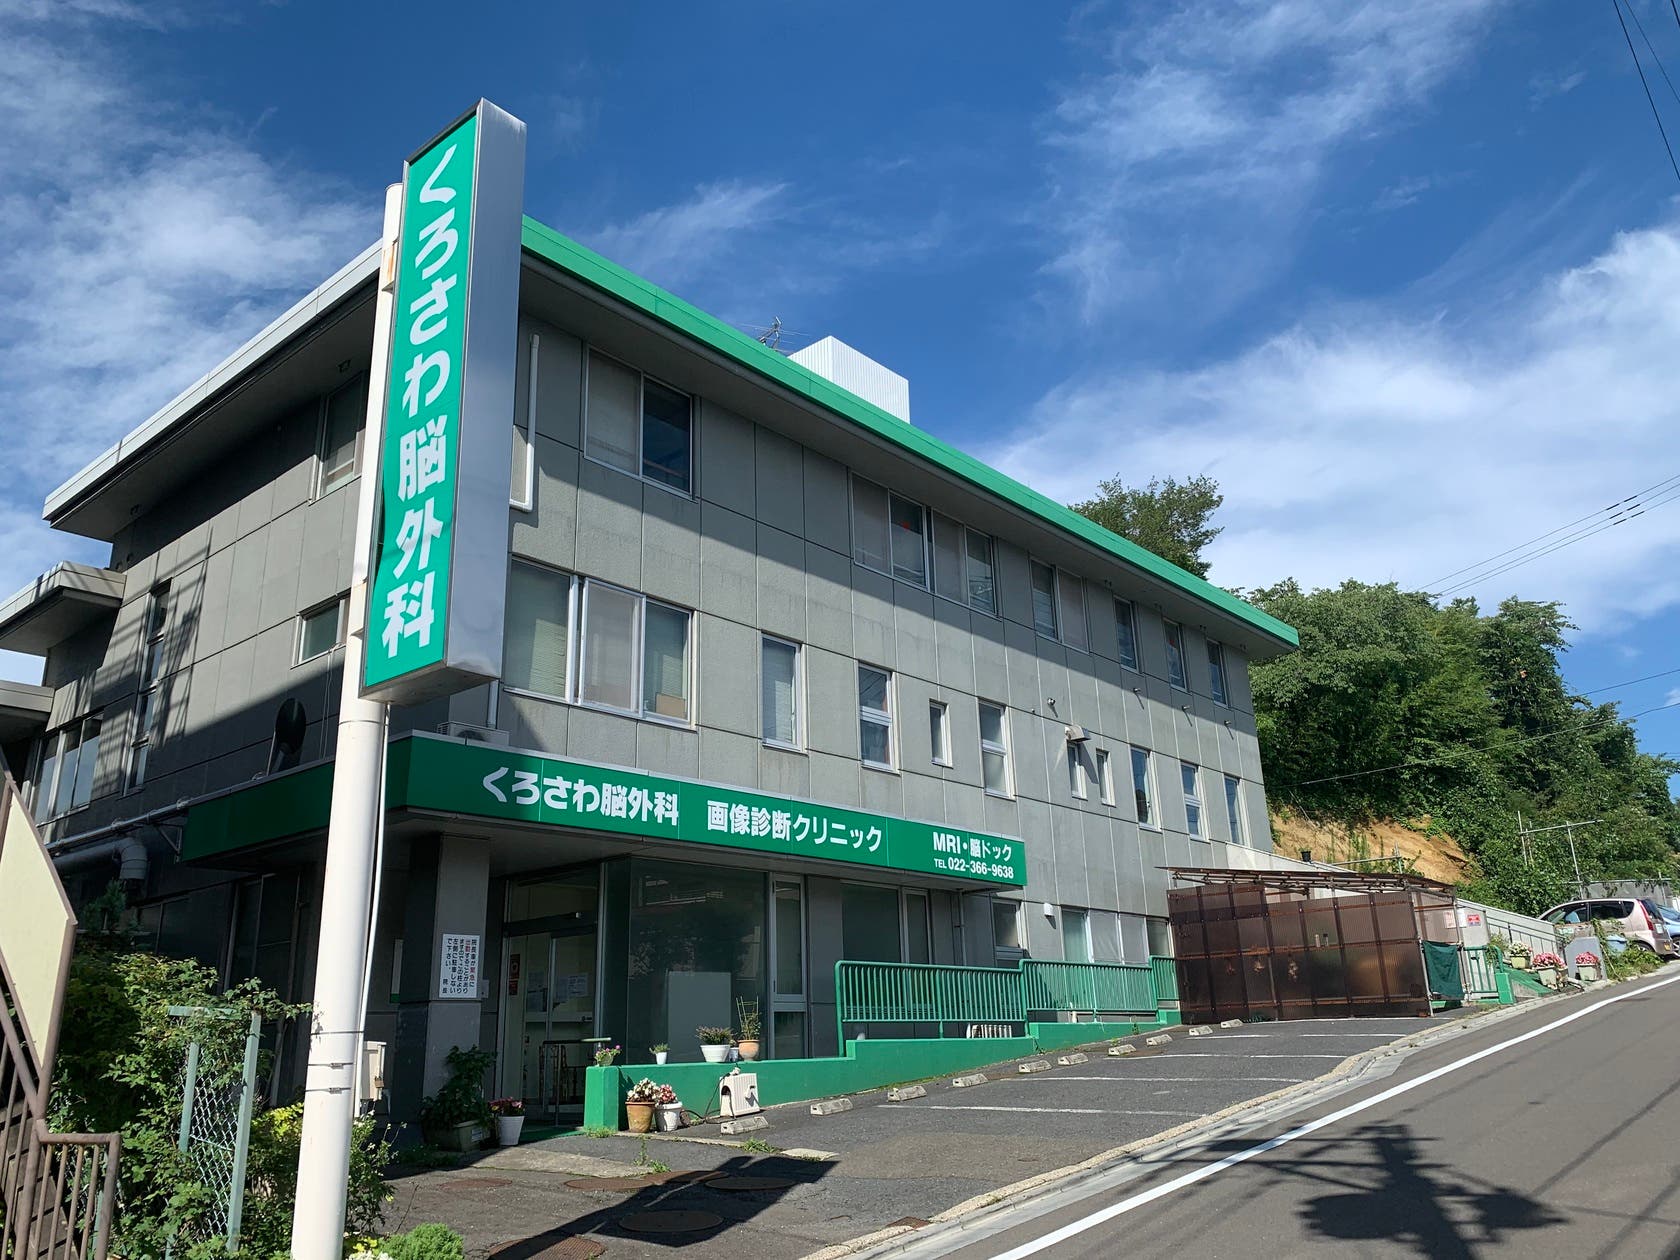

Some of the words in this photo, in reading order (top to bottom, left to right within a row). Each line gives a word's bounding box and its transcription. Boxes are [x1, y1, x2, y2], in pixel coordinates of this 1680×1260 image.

[382, 143, 459, 658] くろさわ脳外科
[482, 766, 679, 826] くろさわ脳外科
[707, 799, 882, 852] 画像診断クリニック
[934, 857, 947, 869] TEL
[948, 857, 1014, 879] 022-366-9638
